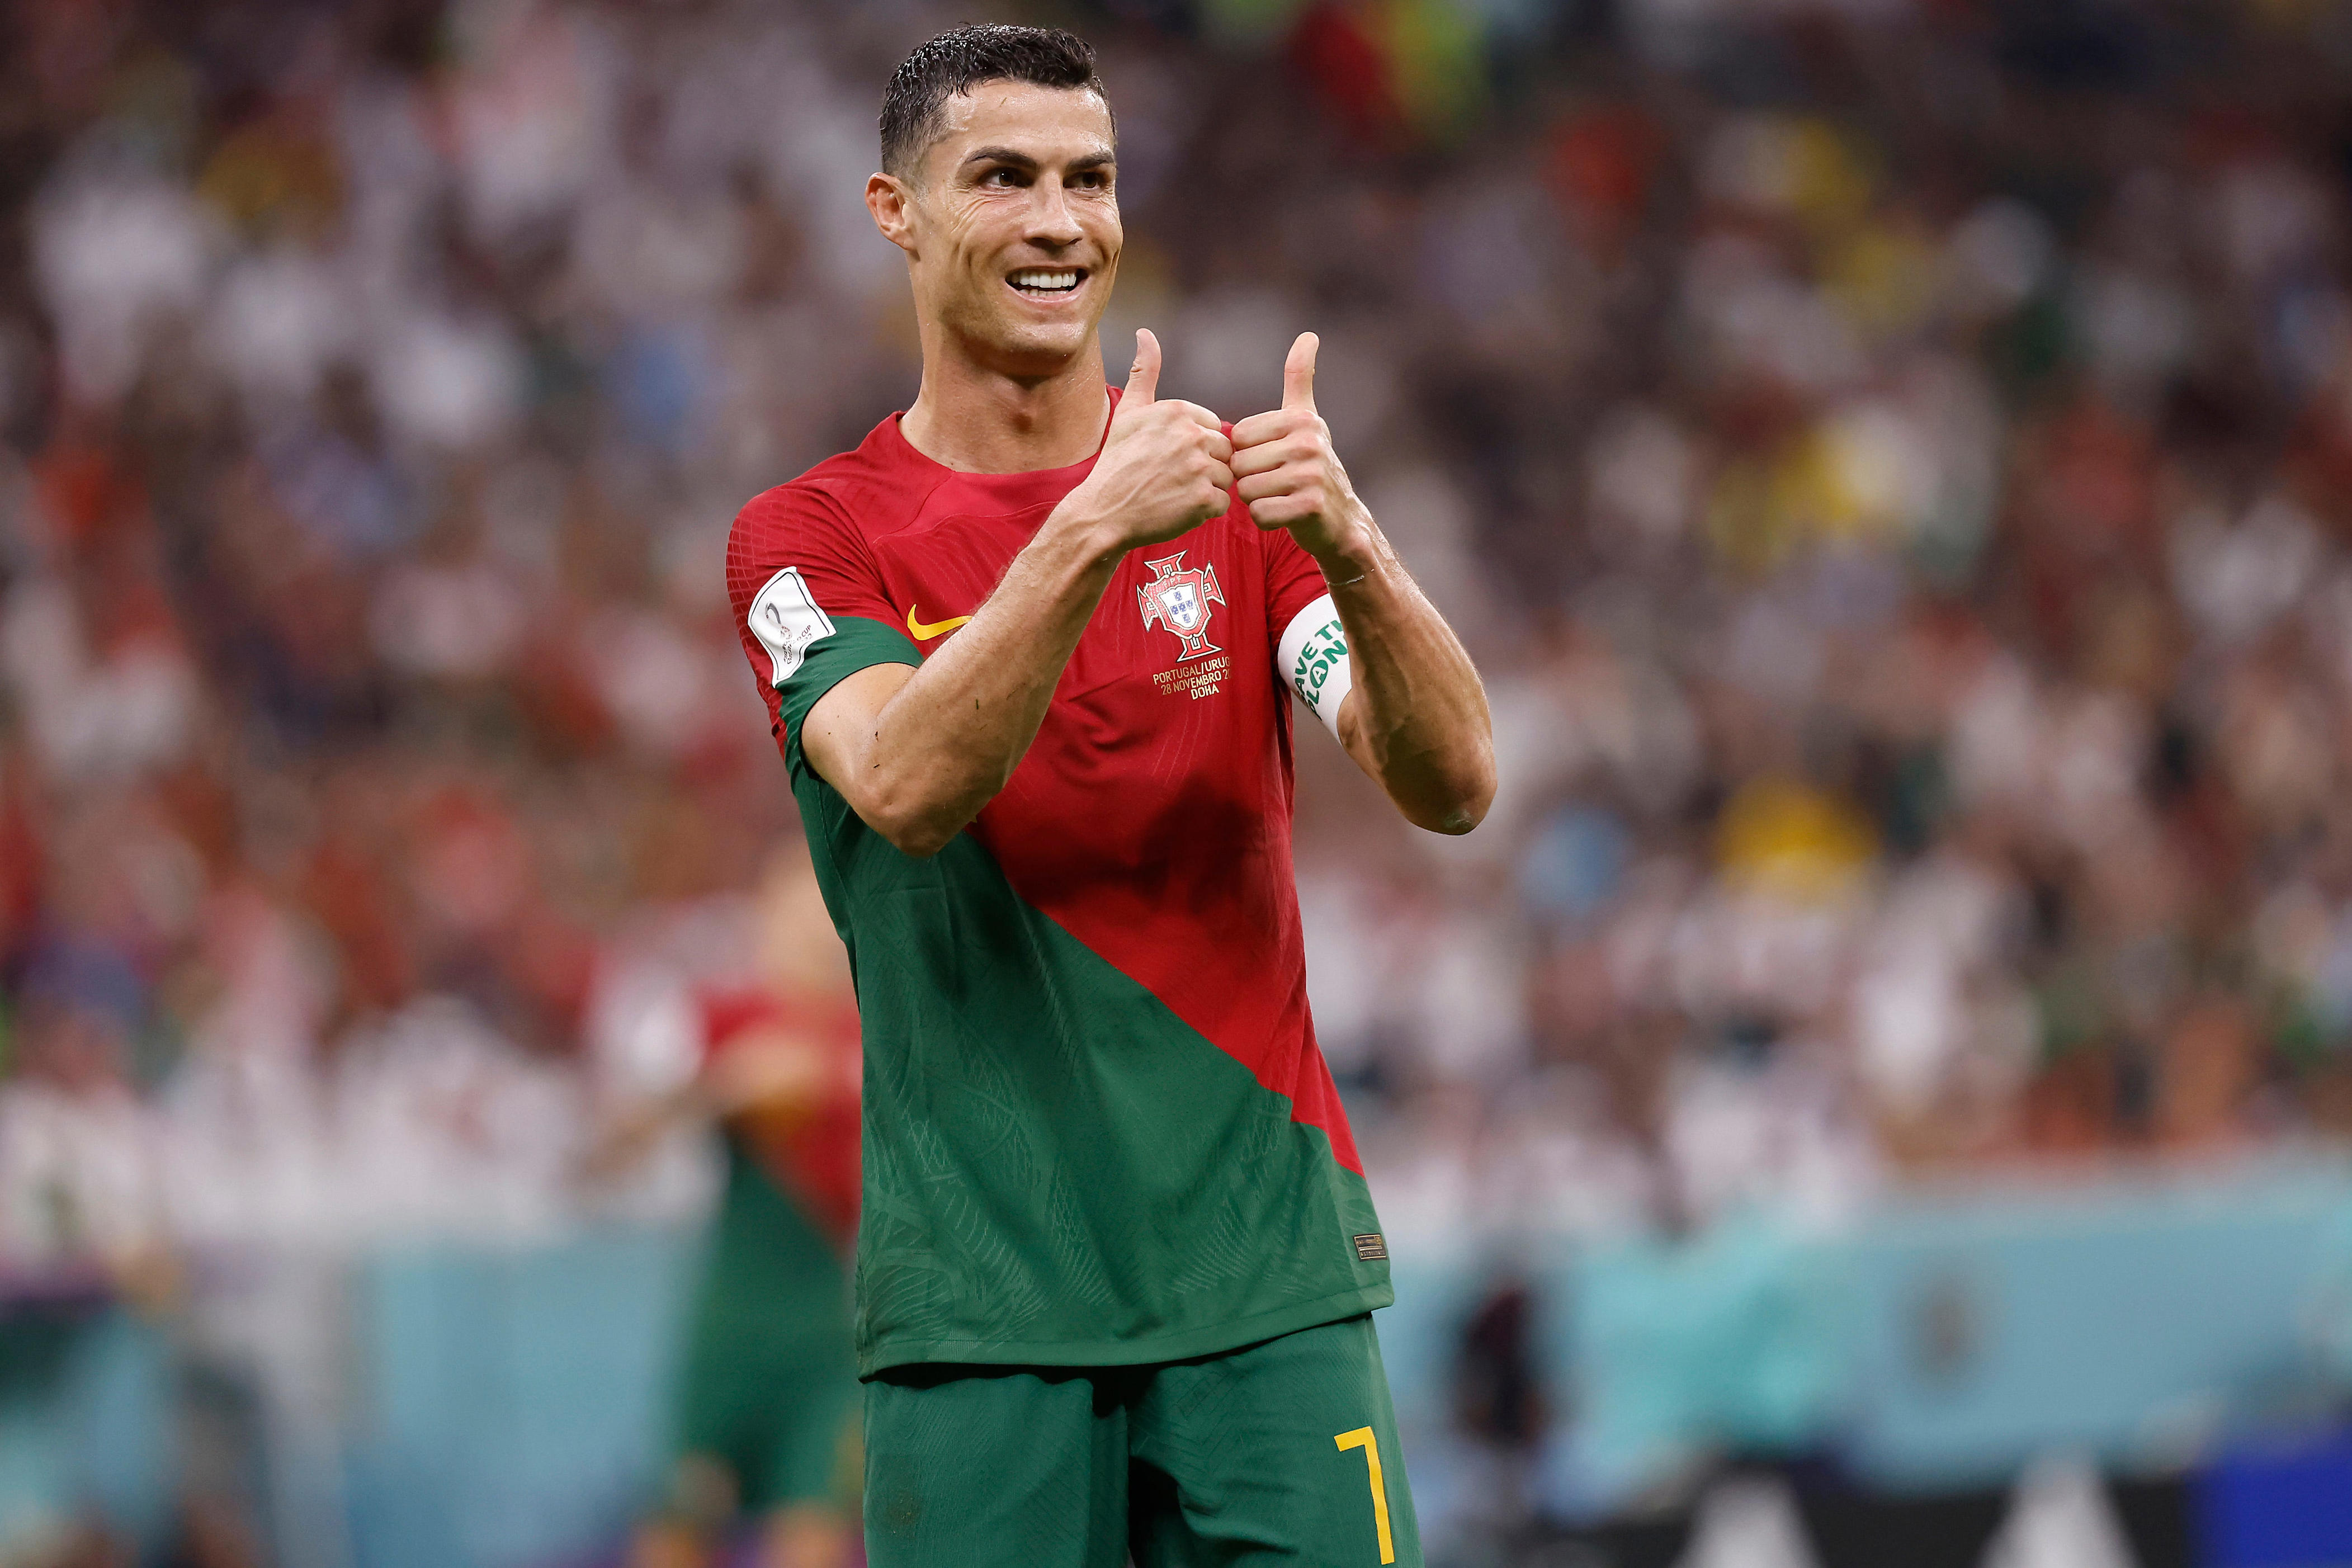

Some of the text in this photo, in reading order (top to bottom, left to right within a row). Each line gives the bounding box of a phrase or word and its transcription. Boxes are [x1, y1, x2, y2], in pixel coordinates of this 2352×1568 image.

[801, 625, 811, 637] CUP
[1161, 683, 1172, 695] 28
[1173, 670, 1222, 692] NOVEMBRO
[1191, 683, 1220, 700] DOHA
[1295, 641, 1318, 707] AVE
[1307, 640, 1348, 721] PLAN
[1334, 1426, 1395, 1565] 7
